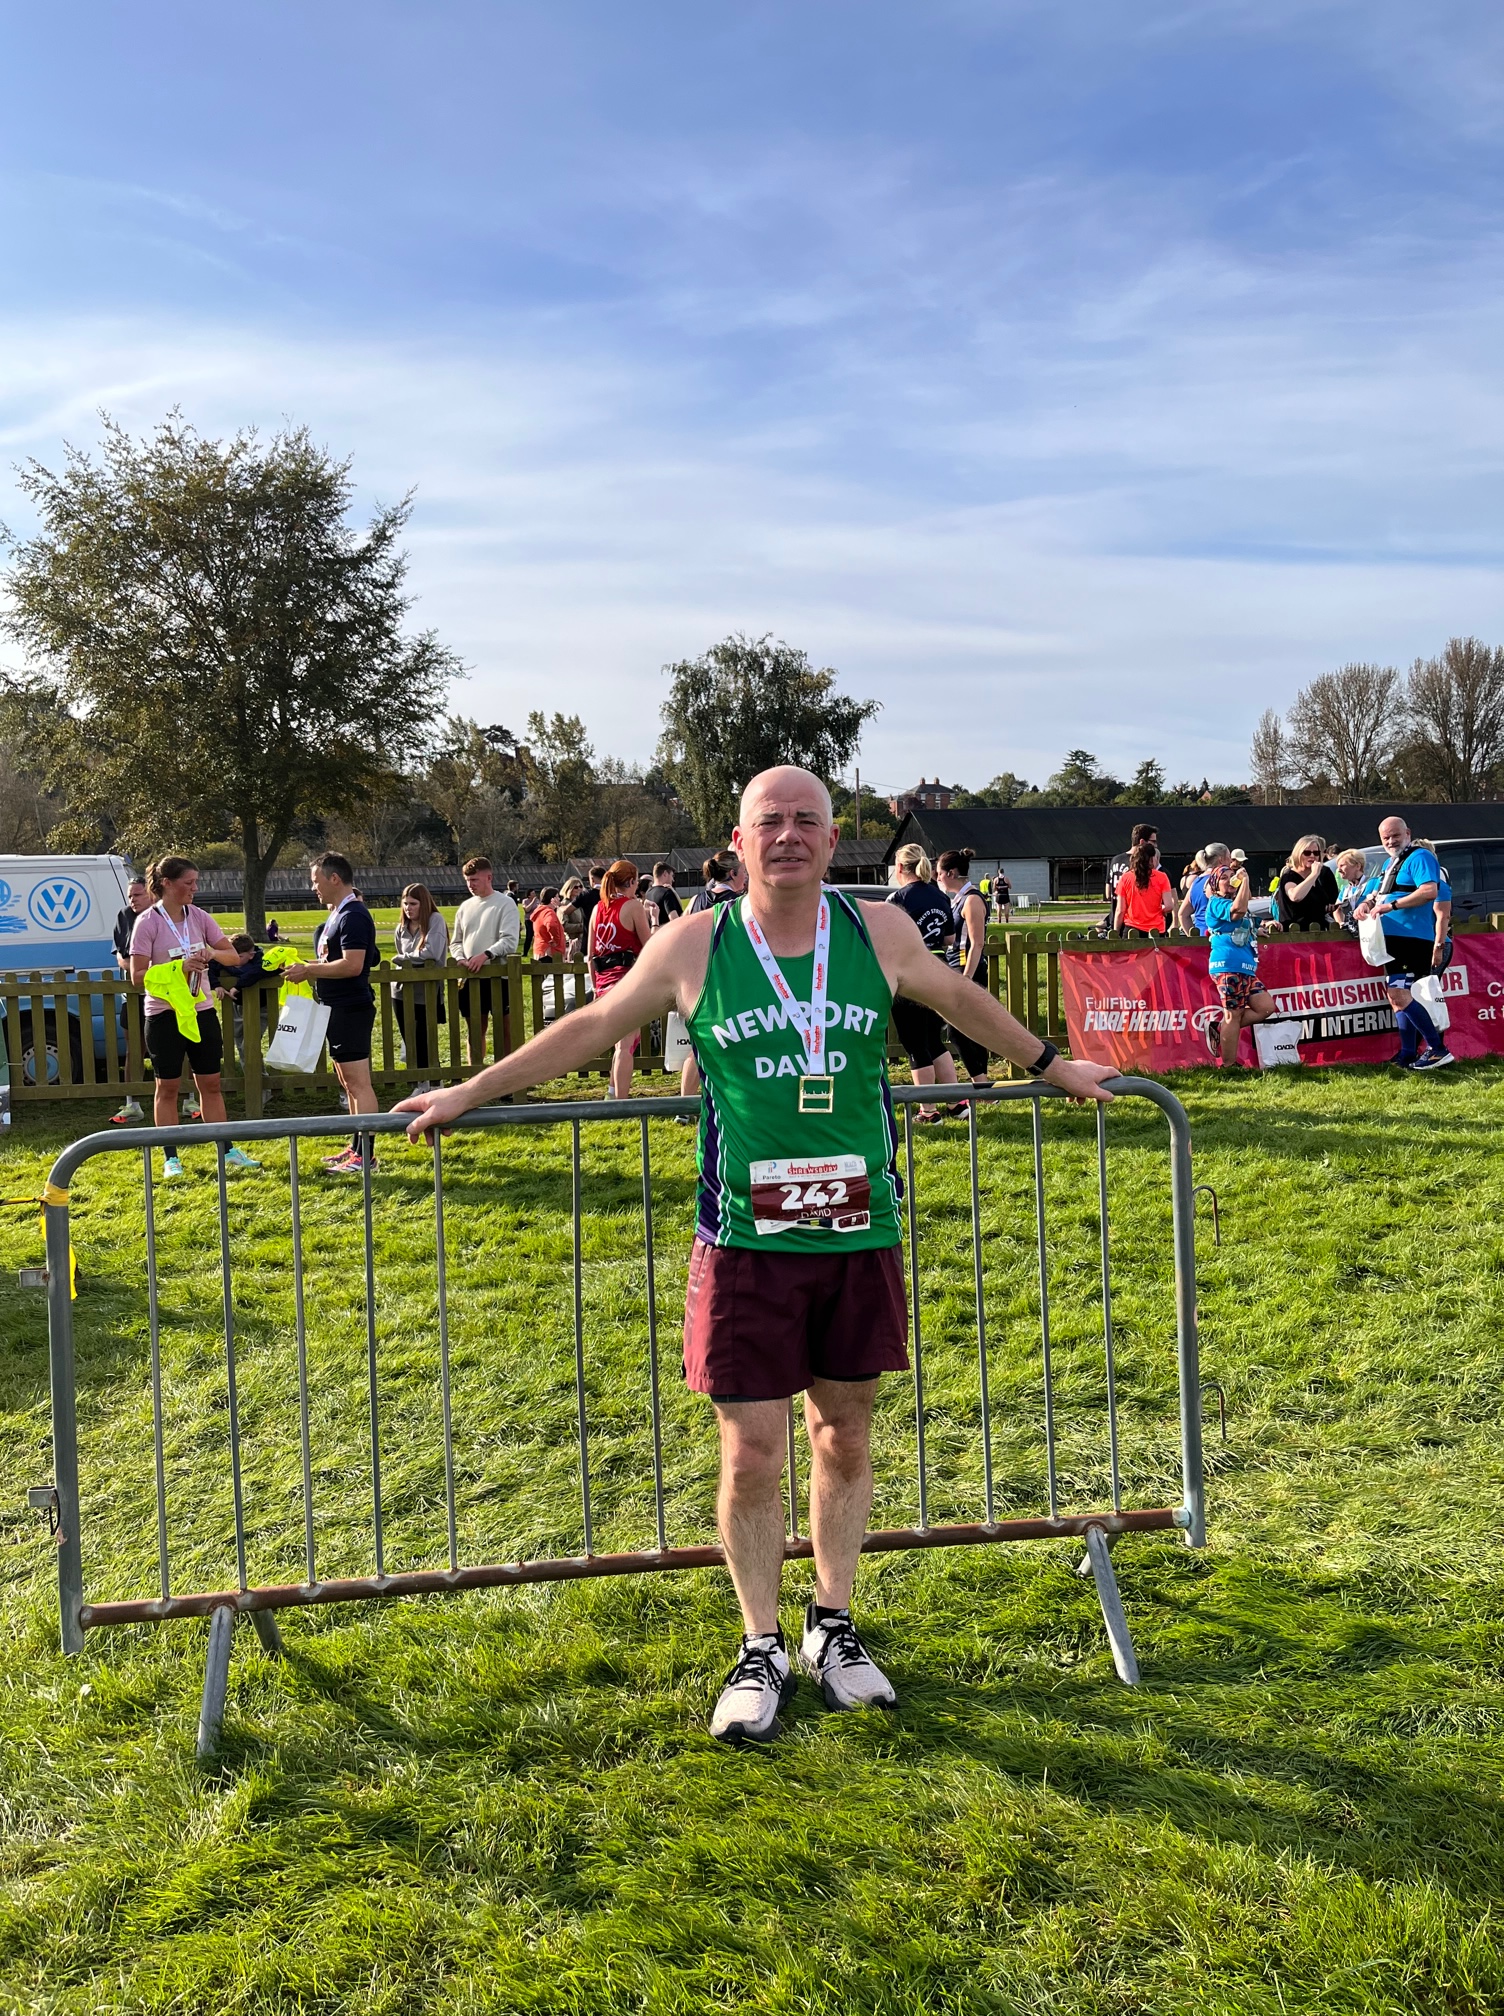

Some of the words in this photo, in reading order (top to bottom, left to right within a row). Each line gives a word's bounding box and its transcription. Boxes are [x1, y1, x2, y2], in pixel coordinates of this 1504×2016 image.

[1085, 997, 1147, 1010] FullFibre
[1272, 981, 1389, 1013] XTINGUISHIN
[1084, 1010, 1129, 1032] FIBRE
[1128, 1009, 1188, 1031] HEROES
[1478, 1005, 1496, 1020] at
[755, 1050, 847, 1079] DAVD
[787, 1163, 838, 1175] SHREWSBURY
[779, 1181, 849, 1210] 242
[800, 1207, 832, 1219] DAVID
